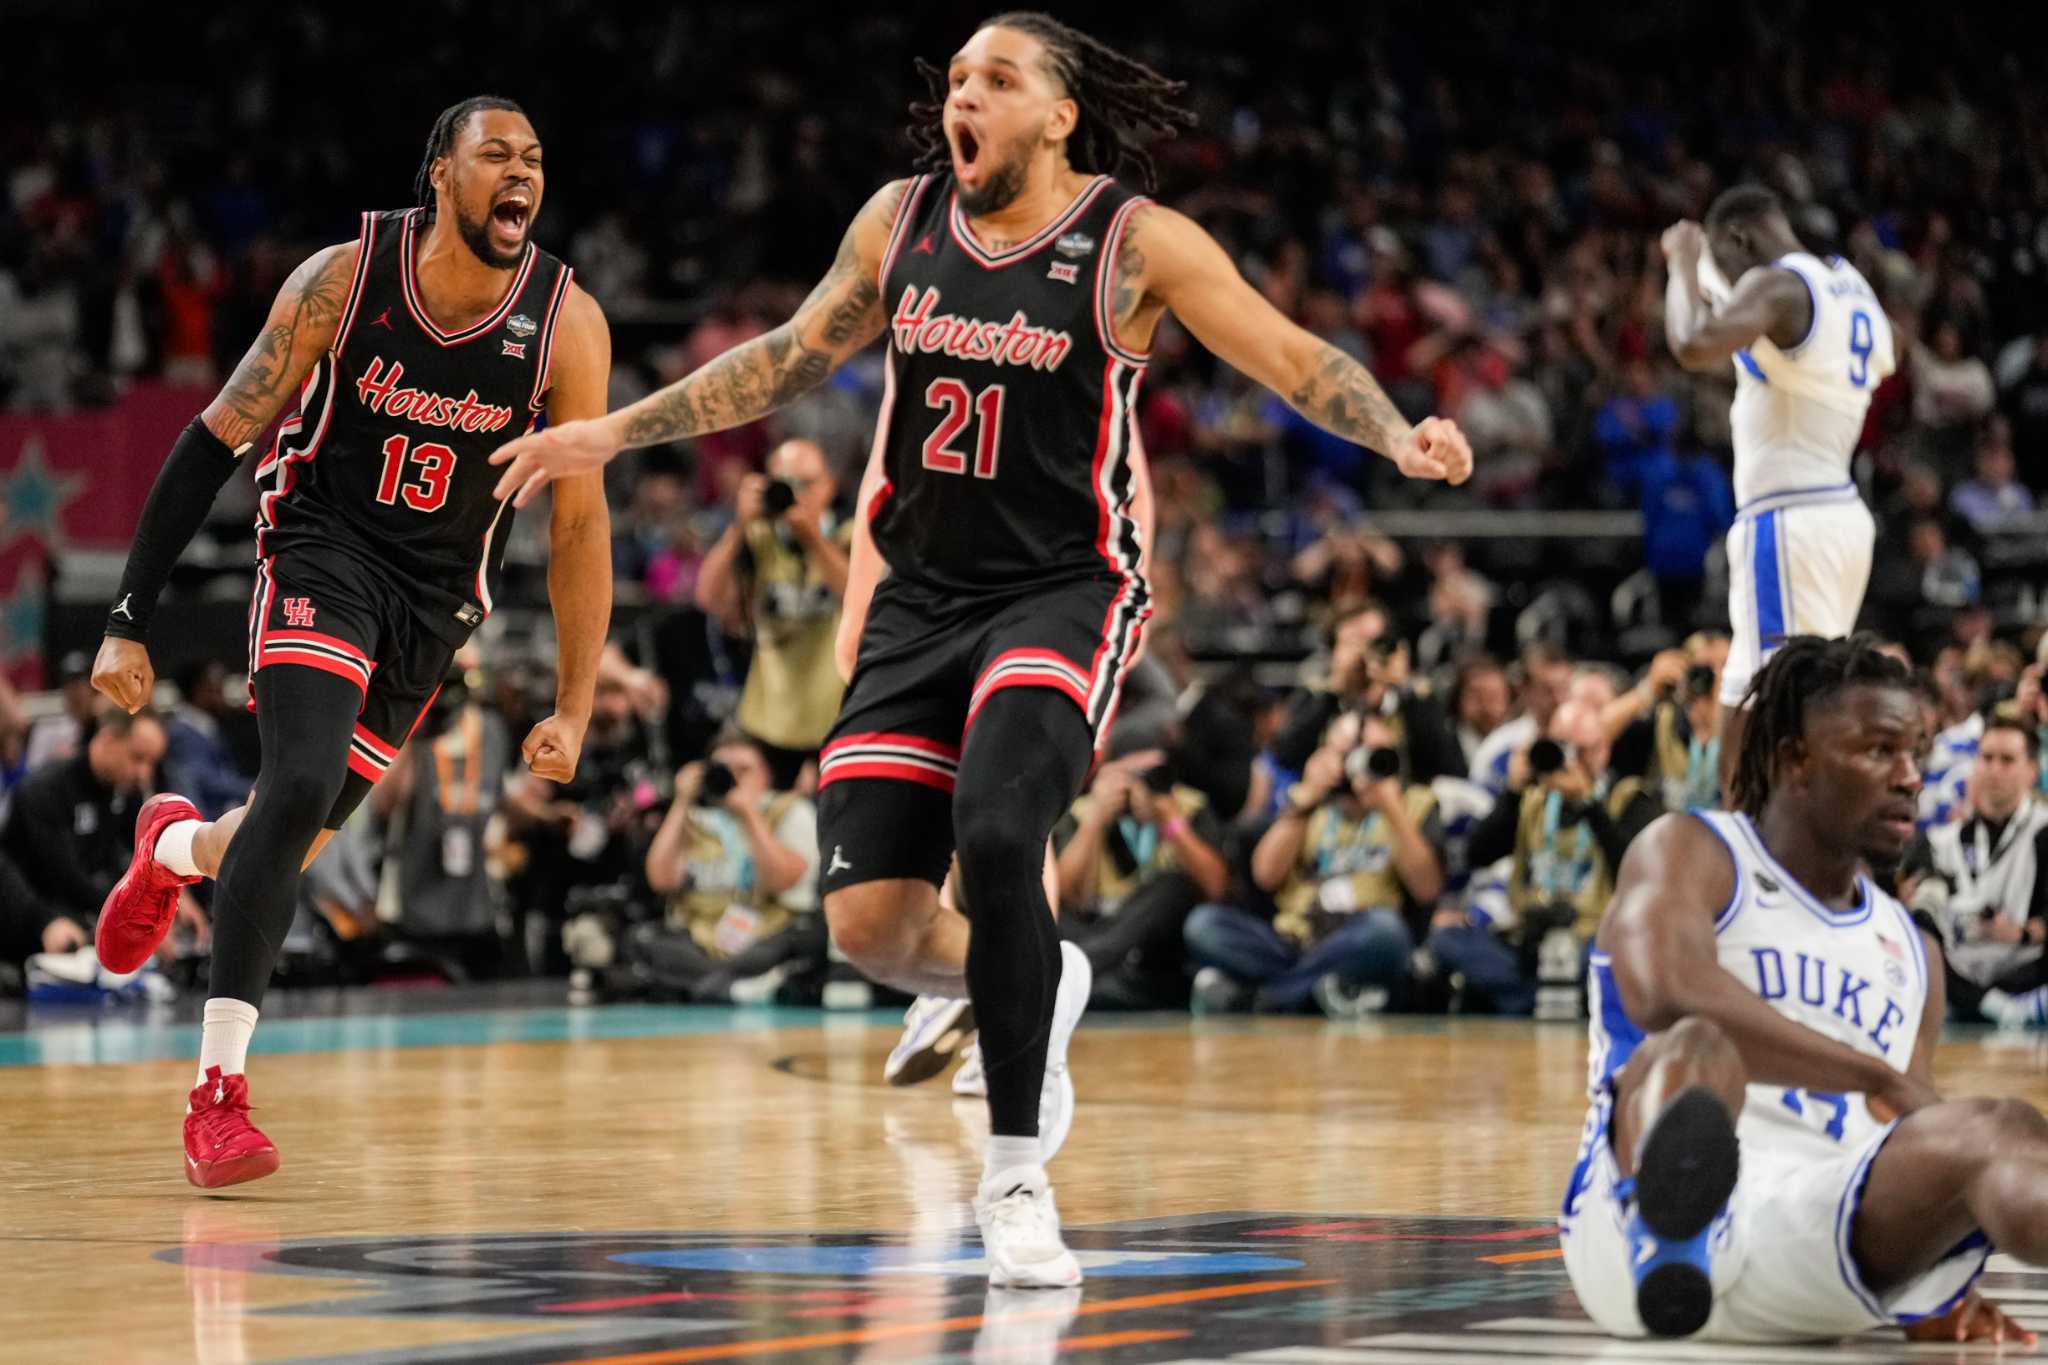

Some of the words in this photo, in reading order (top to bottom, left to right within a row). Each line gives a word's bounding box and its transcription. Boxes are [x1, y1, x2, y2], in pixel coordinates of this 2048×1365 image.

[892, 284, 1073, 372] Houston
[1850, 310, 1873, 388] 9
[356, 356, 512, 433] Houston
[922, 377, 1006, 479] 21
[376, 433, 457, 513] 13
[1749, 946, 1904, 1055] DUKE
